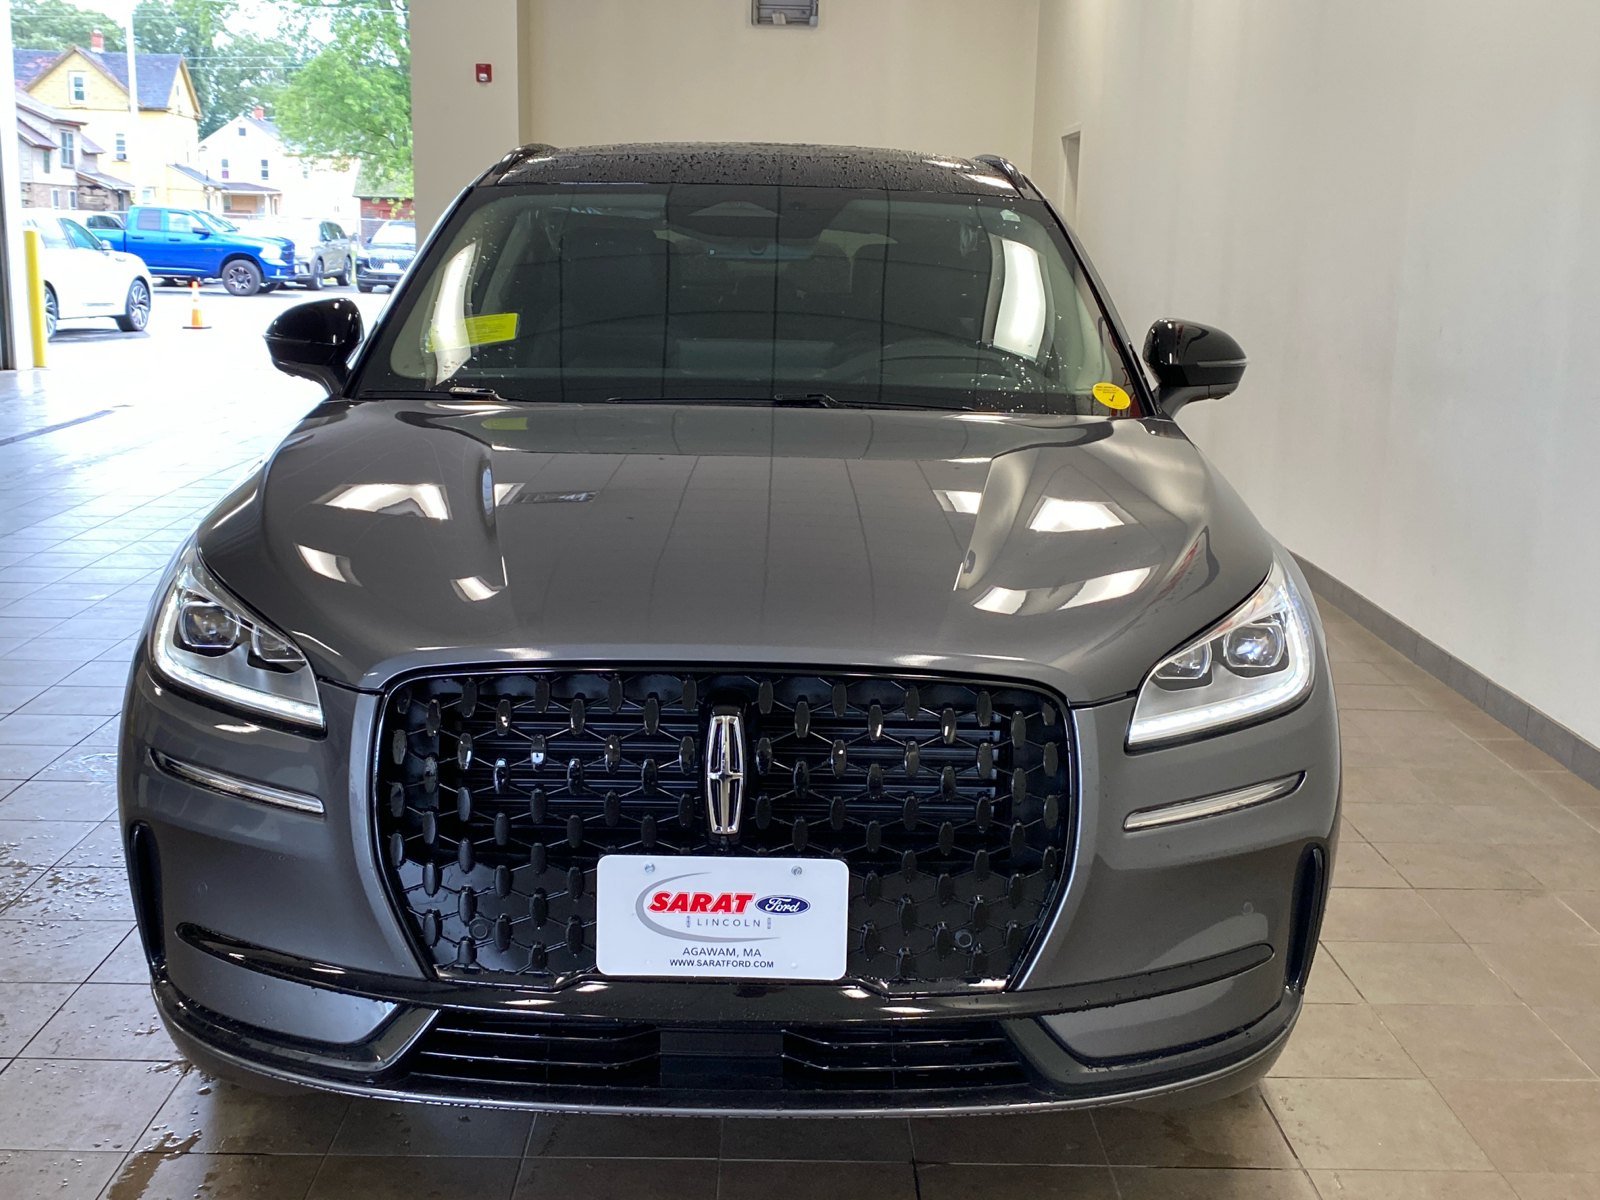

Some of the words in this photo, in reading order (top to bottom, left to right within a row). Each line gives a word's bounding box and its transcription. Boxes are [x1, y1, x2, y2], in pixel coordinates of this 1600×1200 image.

[648, 890, 756, 914] SARAT
[765, 897, 801, 913] Ford
[697, 918, 761, 927] LINCOLN
[682, 947, 739, 957] AGAWAM,
[743, 948, 762, 957] MA
[669, 959, 774, 968] WWW.SARATFORD.COM
